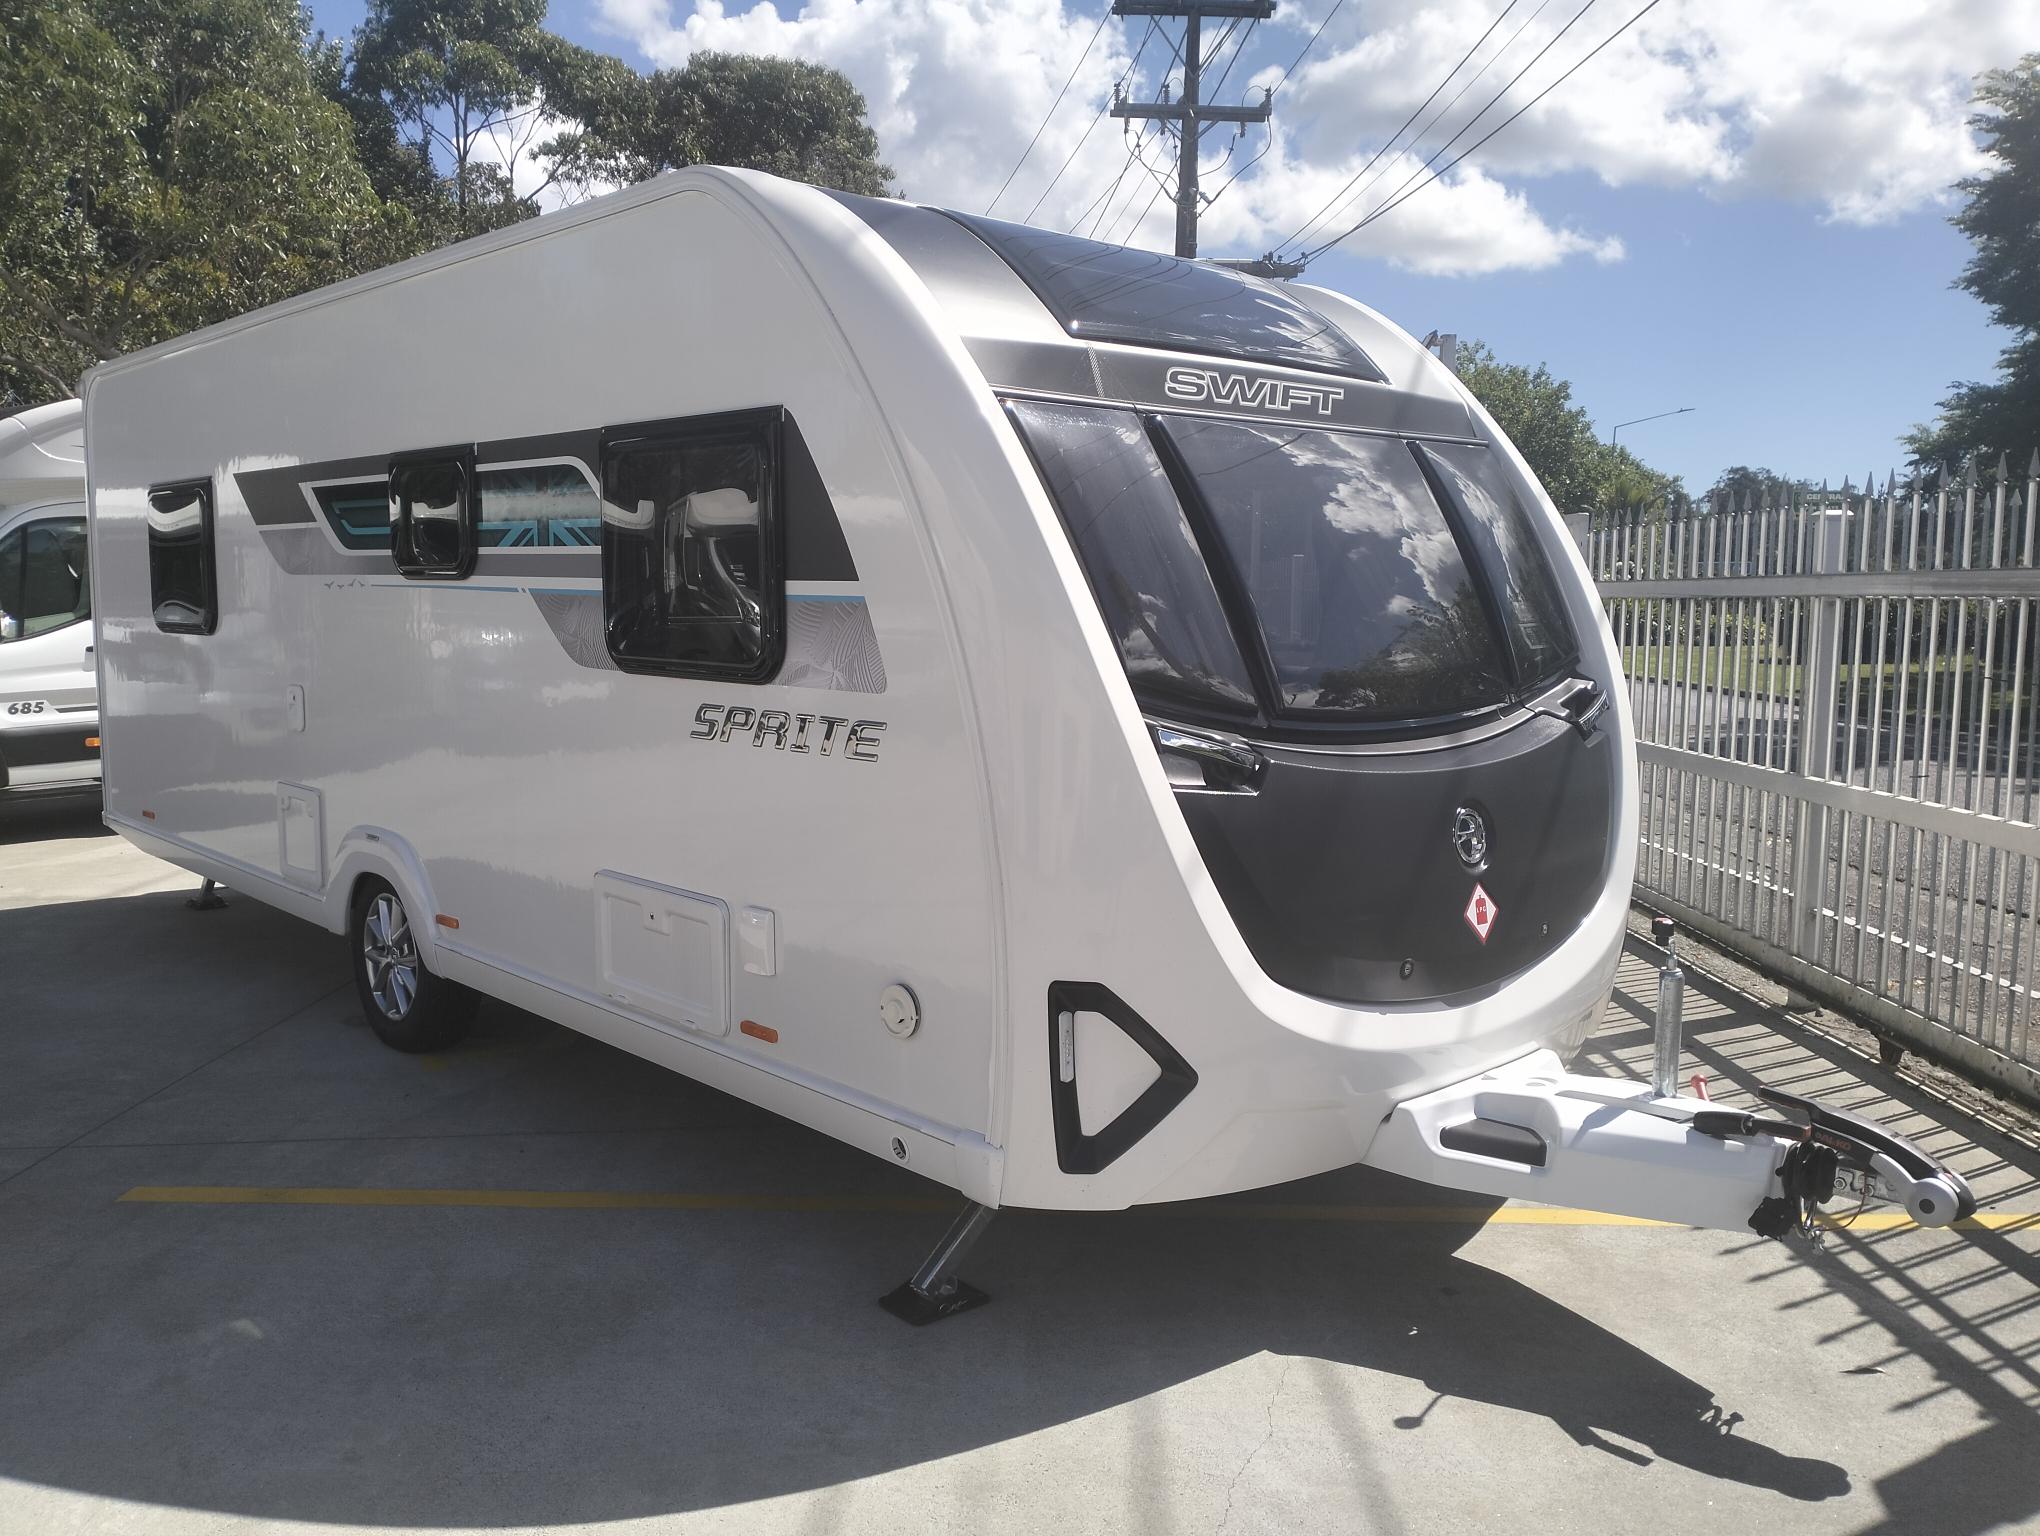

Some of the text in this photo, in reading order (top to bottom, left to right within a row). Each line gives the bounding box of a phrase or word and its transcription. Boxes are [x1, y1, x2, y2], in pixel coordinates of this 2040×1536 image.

[1165, 367, 1344, 415] SWIFT
[8, 701, 45, 715] 685
[690, 703, 888, 763] SPRITE
